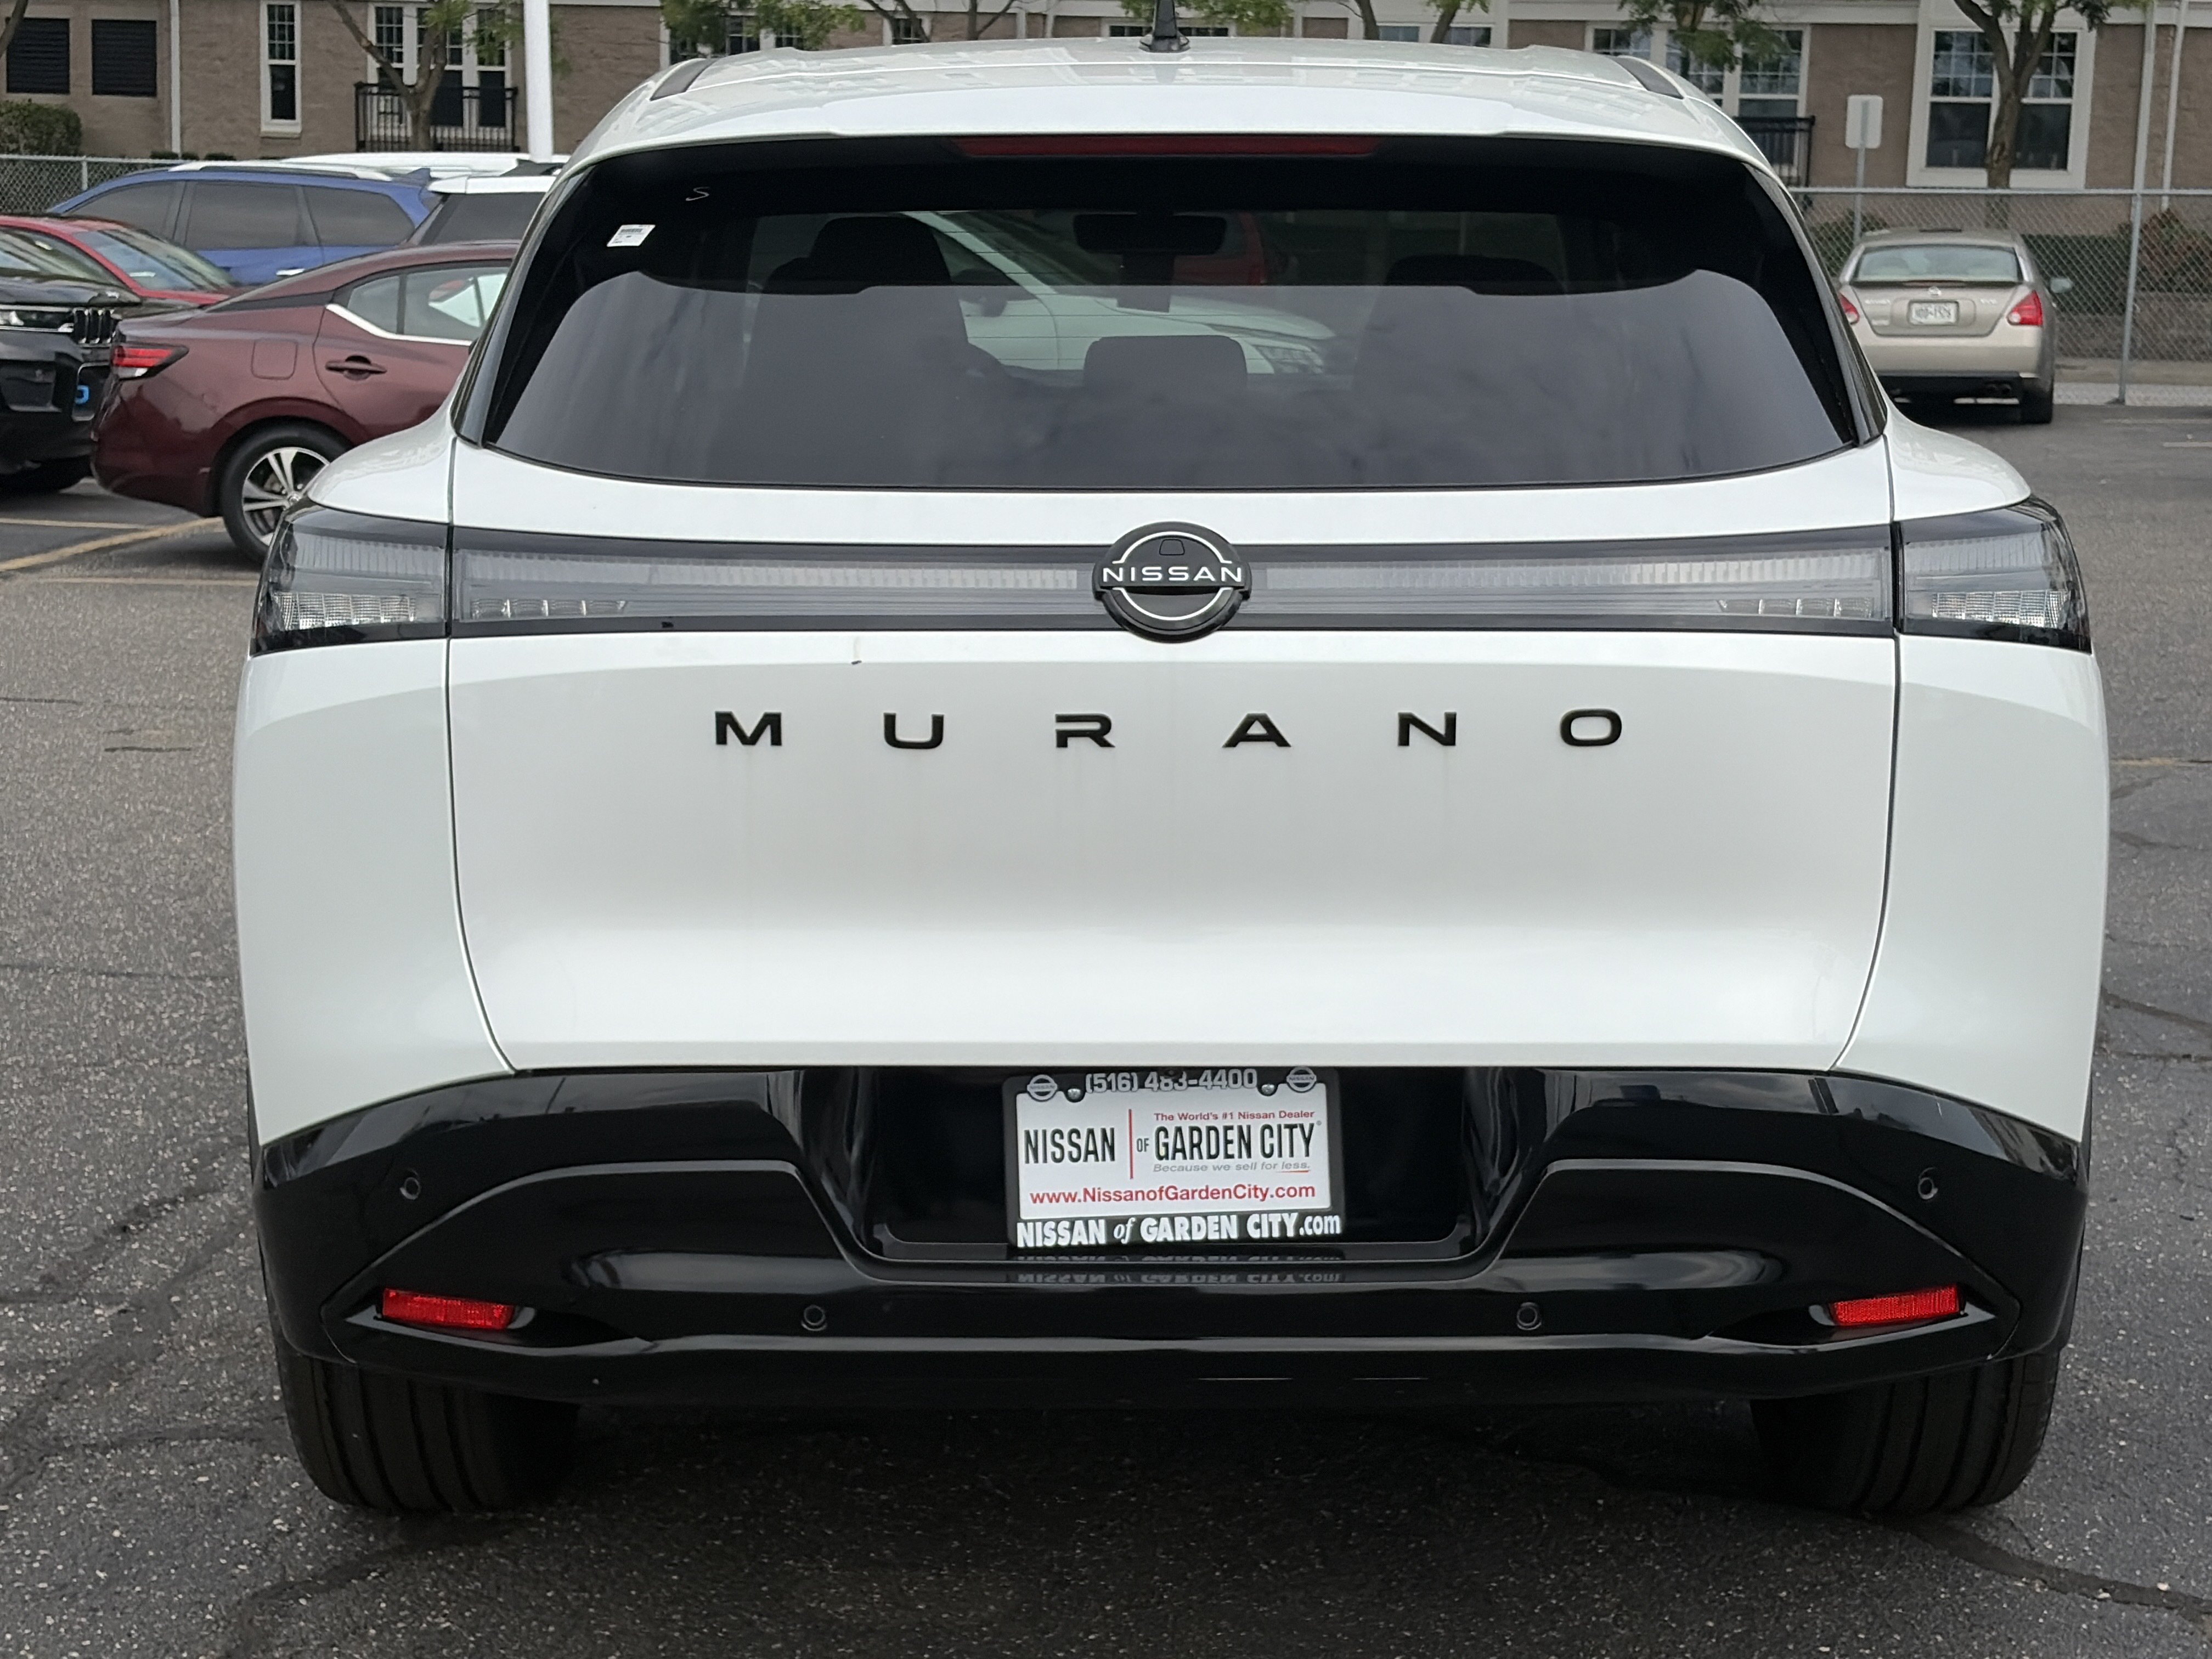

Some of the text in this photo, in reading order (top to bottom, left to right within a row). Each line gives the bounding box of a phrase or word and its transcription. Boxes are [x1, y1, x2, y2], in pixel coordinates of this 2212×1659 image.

[1102, 567, 1242, 583] NISSAN
[715, 709, 1622, 749] MURANO
[1085, 1072, 1138, 1093] (516)
[1177, 1111, 1218, 1120] World's
[1222, 1111, 1234, 1120] #1
[1279, 1110, 1315, 1118] Dealer
[1024, 1122, 1315, 1164] NISSAN OF GARDEN CITY
[1153, 1163, 1208, 1172] Because
[1261, 1163, 1277, 1171] for
[1281, 1161, 1310, 1170] less.
[1030, 1184, 1316, 1204] www.NissanofGardenCity.com
[1017, 1212, 1342, 1248] NISSAN of GARDEN CITY.com
